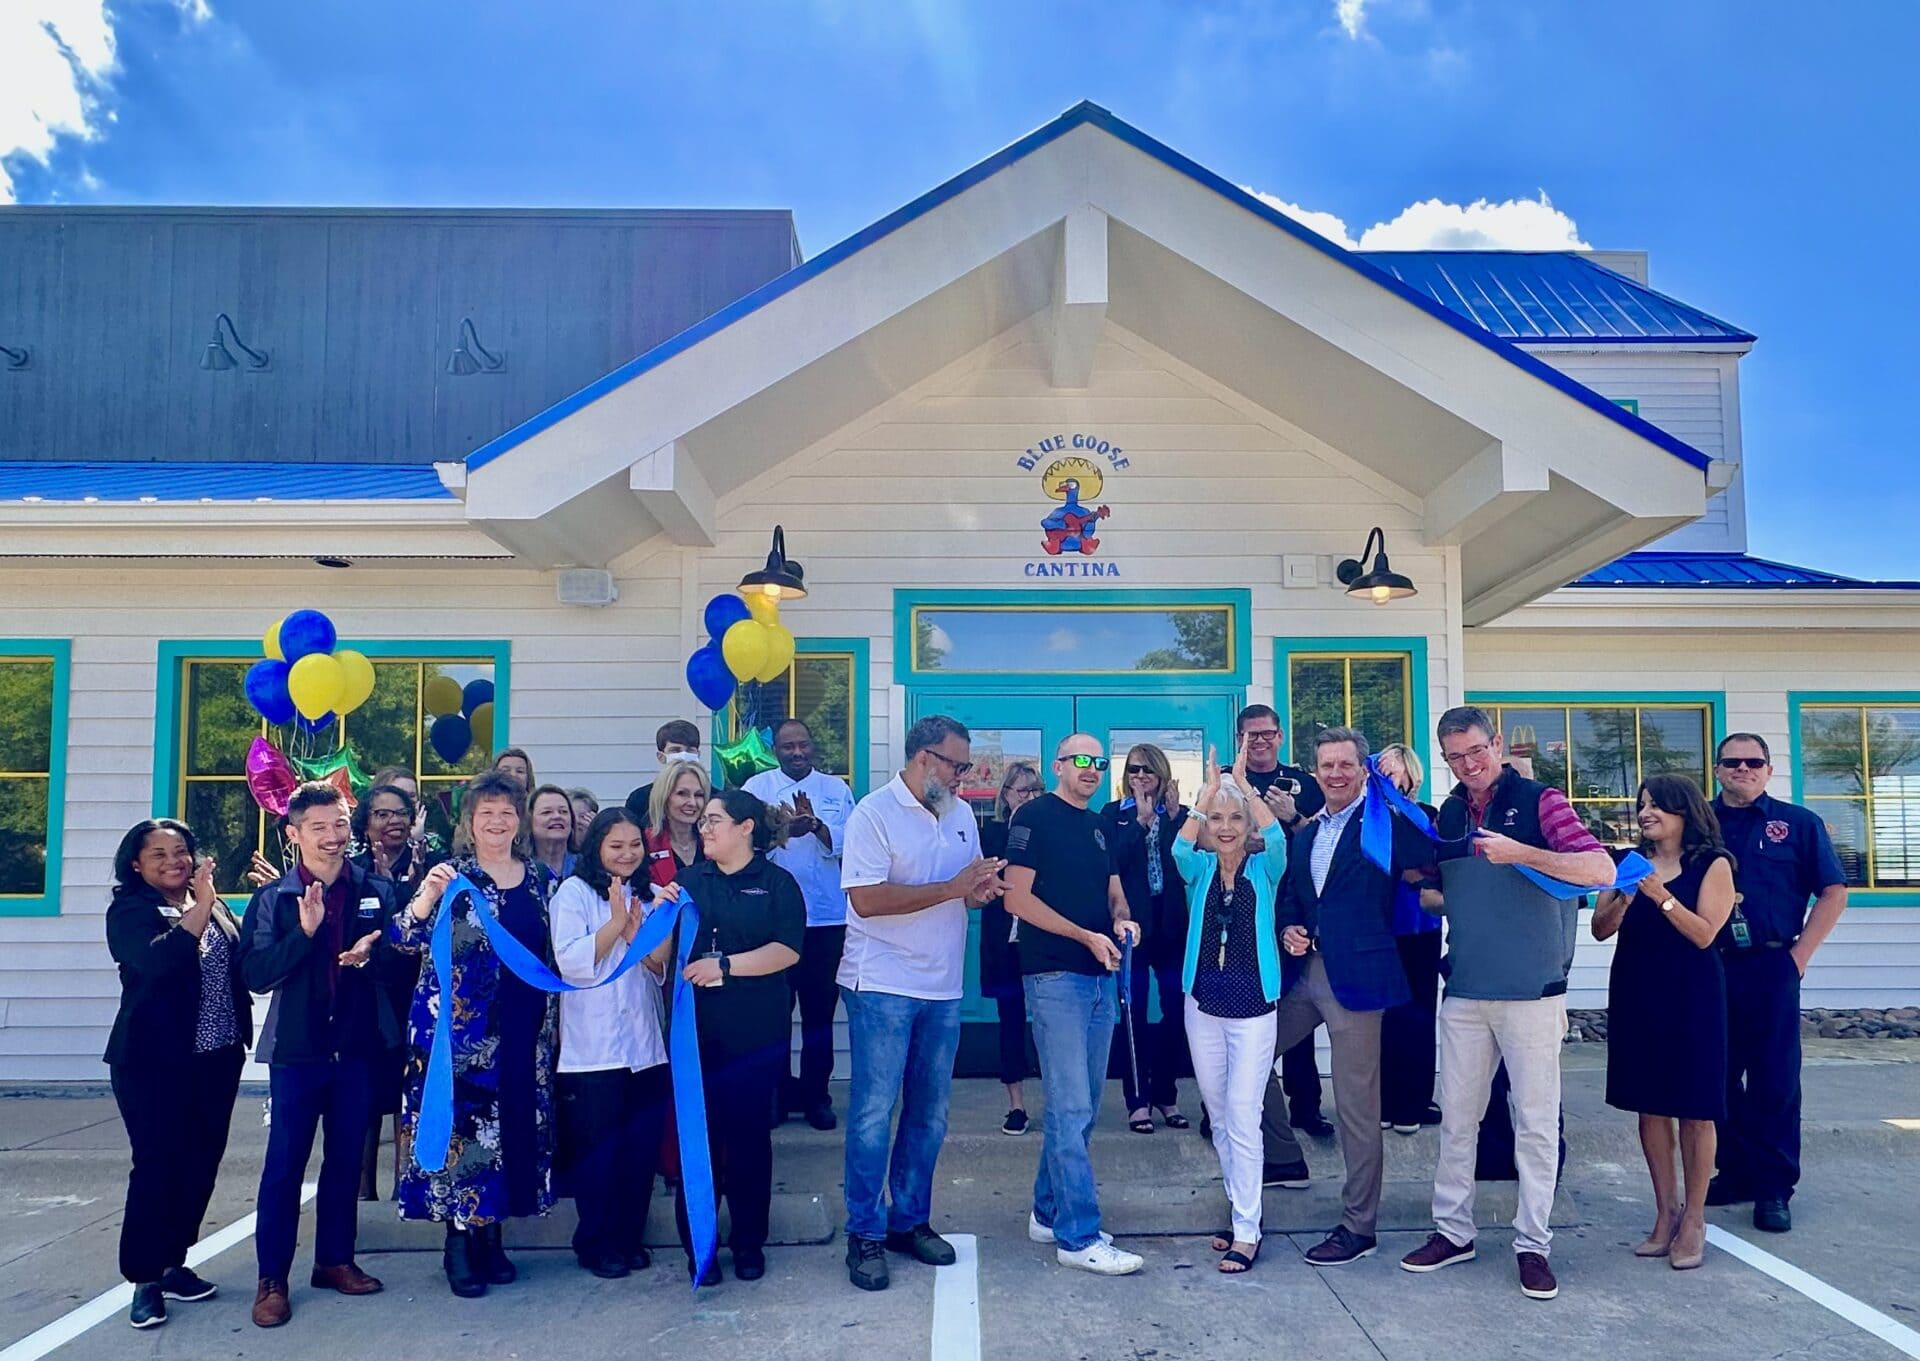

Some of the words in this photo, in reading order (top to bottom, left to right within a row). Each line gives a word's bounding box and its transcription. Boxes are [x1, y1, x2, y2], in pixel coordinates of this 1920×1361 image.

[1017, 434, 1066, 472] BLUE
[1072, 433, 1130, 471] GOOSE
[1024, 562, 1120, 577] CANTINA
